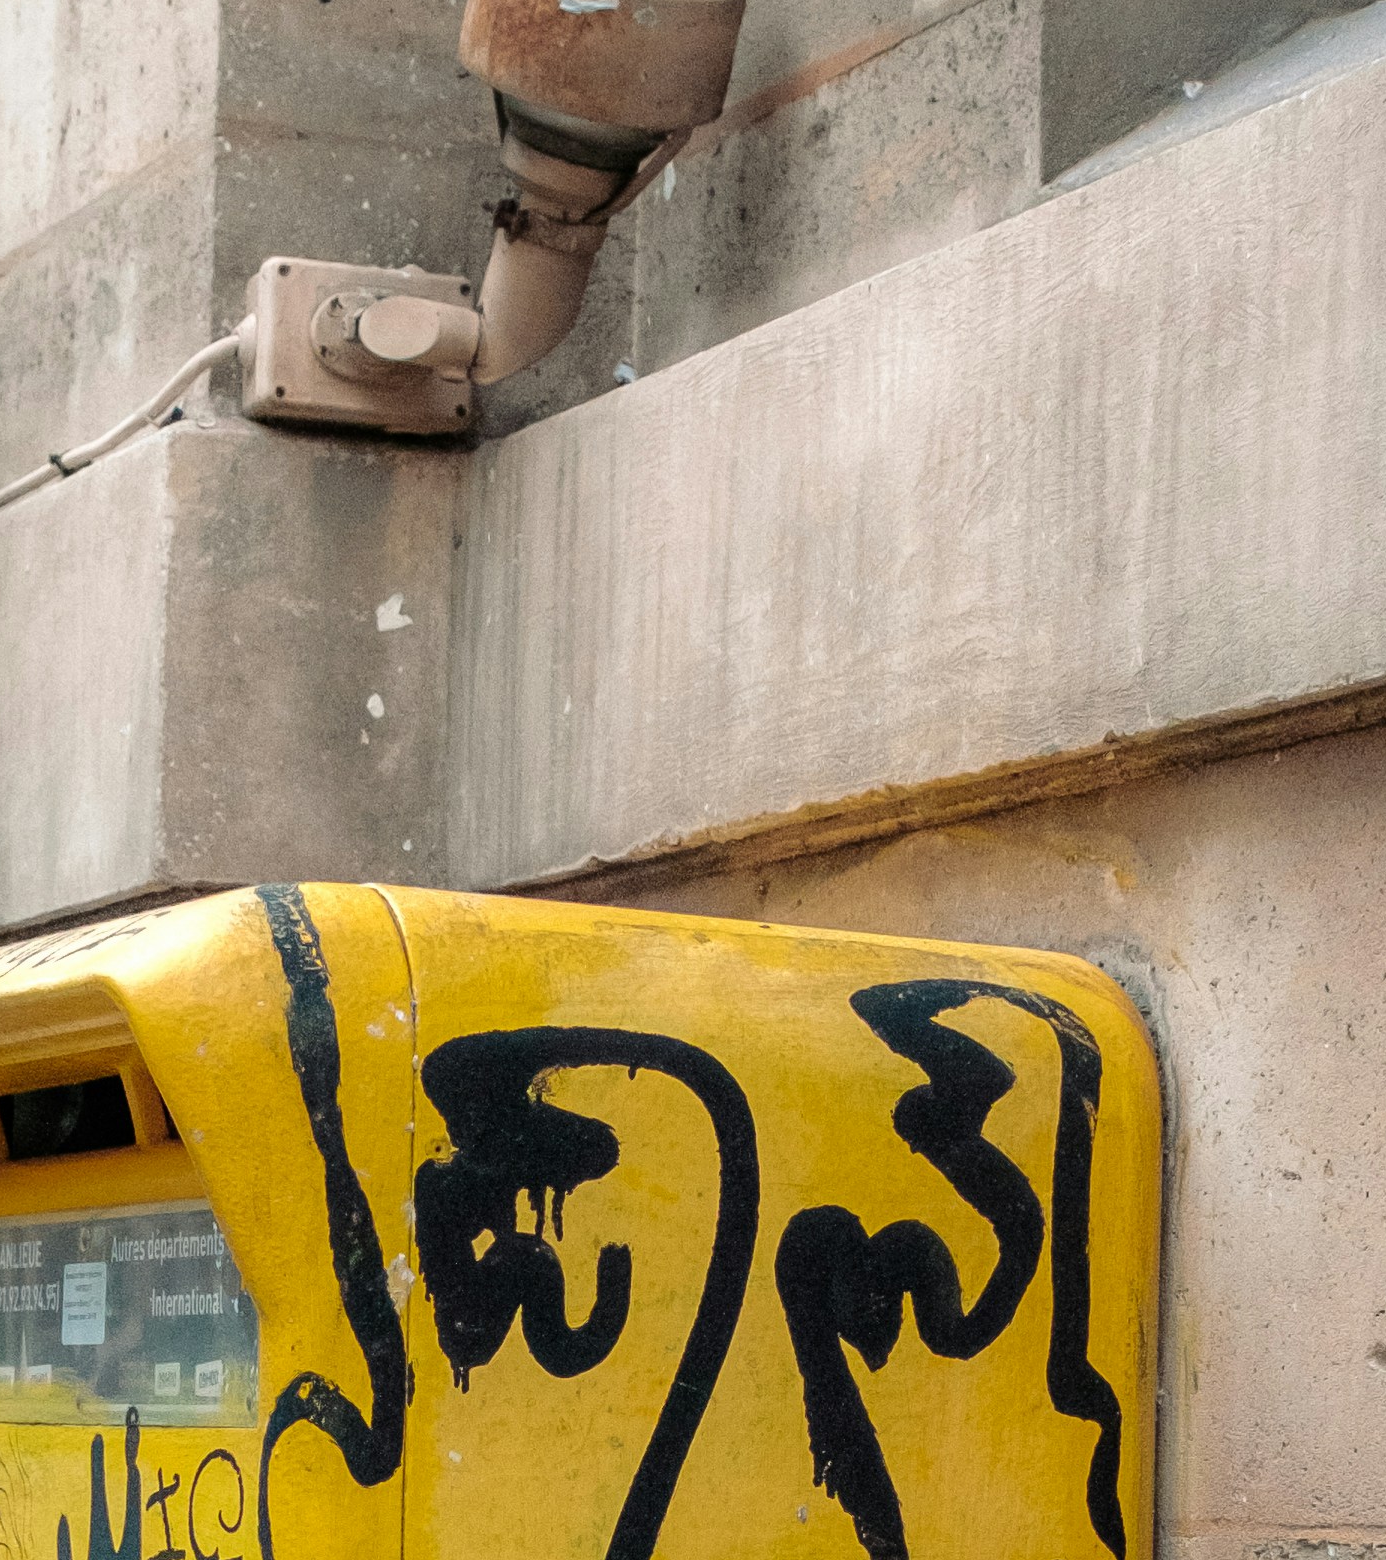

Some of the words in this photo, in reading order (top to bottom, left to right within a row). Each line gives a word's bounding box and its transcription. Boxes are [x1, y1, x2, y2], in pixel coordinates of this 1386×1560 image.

[111, 1237, 145, 1262] Autres
[147, 1228, 225, 1266] départements
[152, 1284, 224, 1316] International
